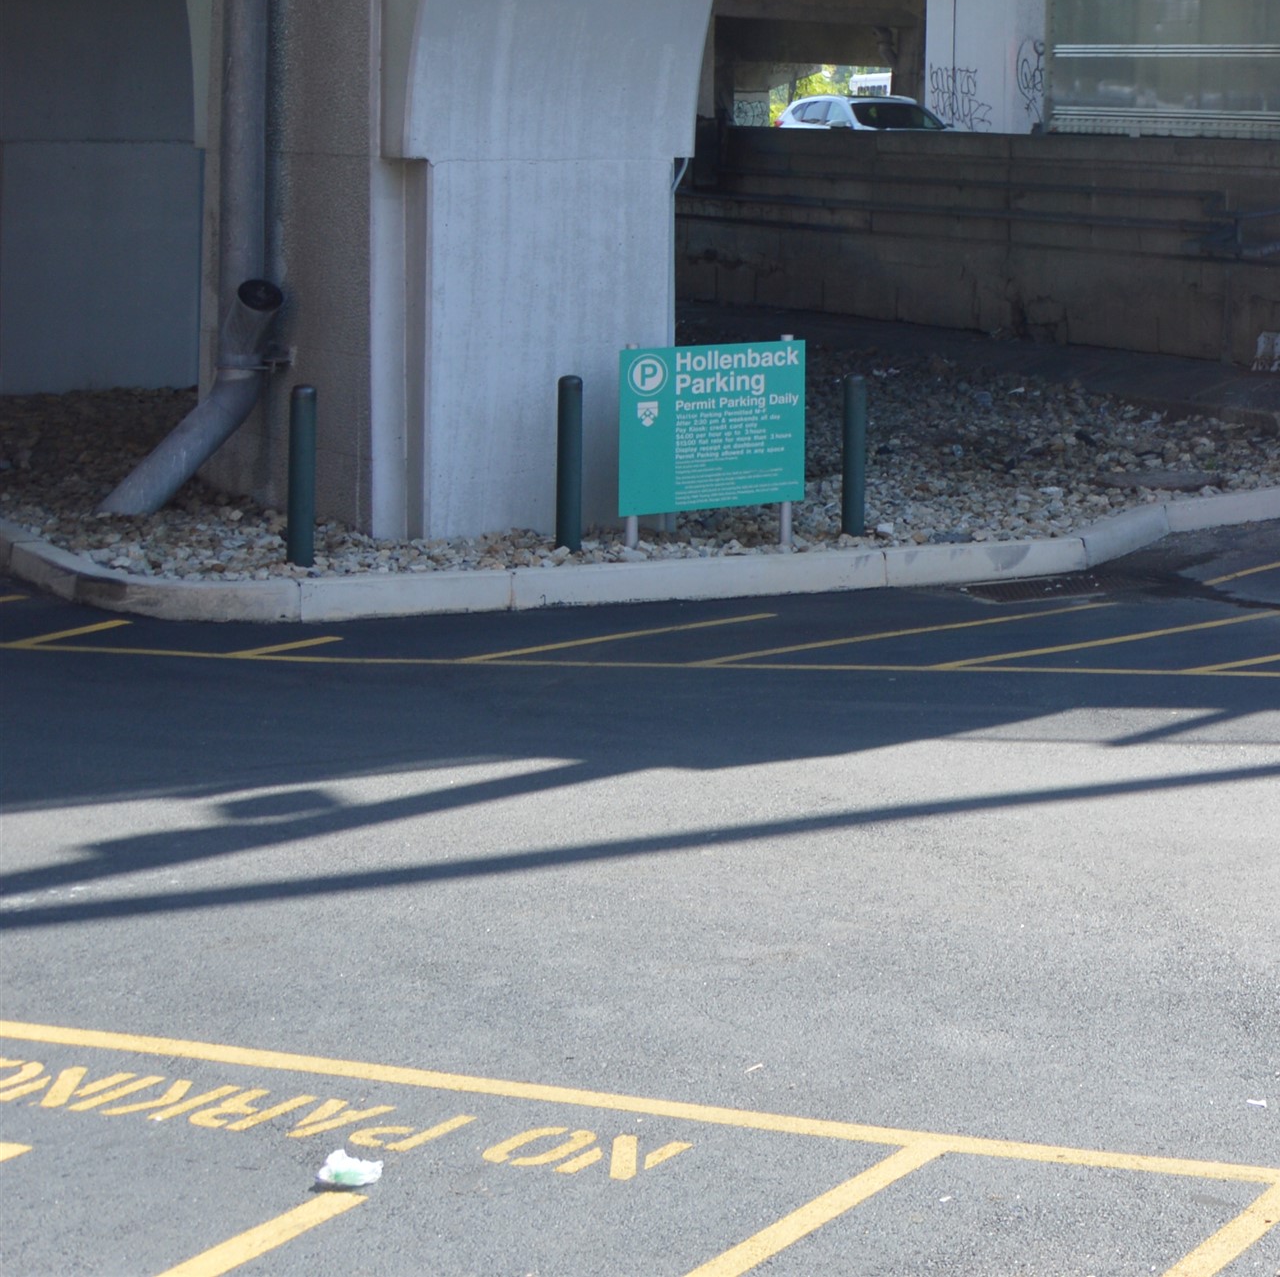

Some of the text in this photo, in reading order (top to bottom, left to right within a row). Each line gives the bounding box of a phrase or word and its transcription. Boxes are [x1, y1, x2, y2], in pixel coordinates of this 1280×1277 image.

[675, 346, 799, 372] Hollenback
[675, 371, 765, 395] Parking
[675, 393, 799, 411] Permit Parking Daily
[482, 1126, 694, 1181] NO
